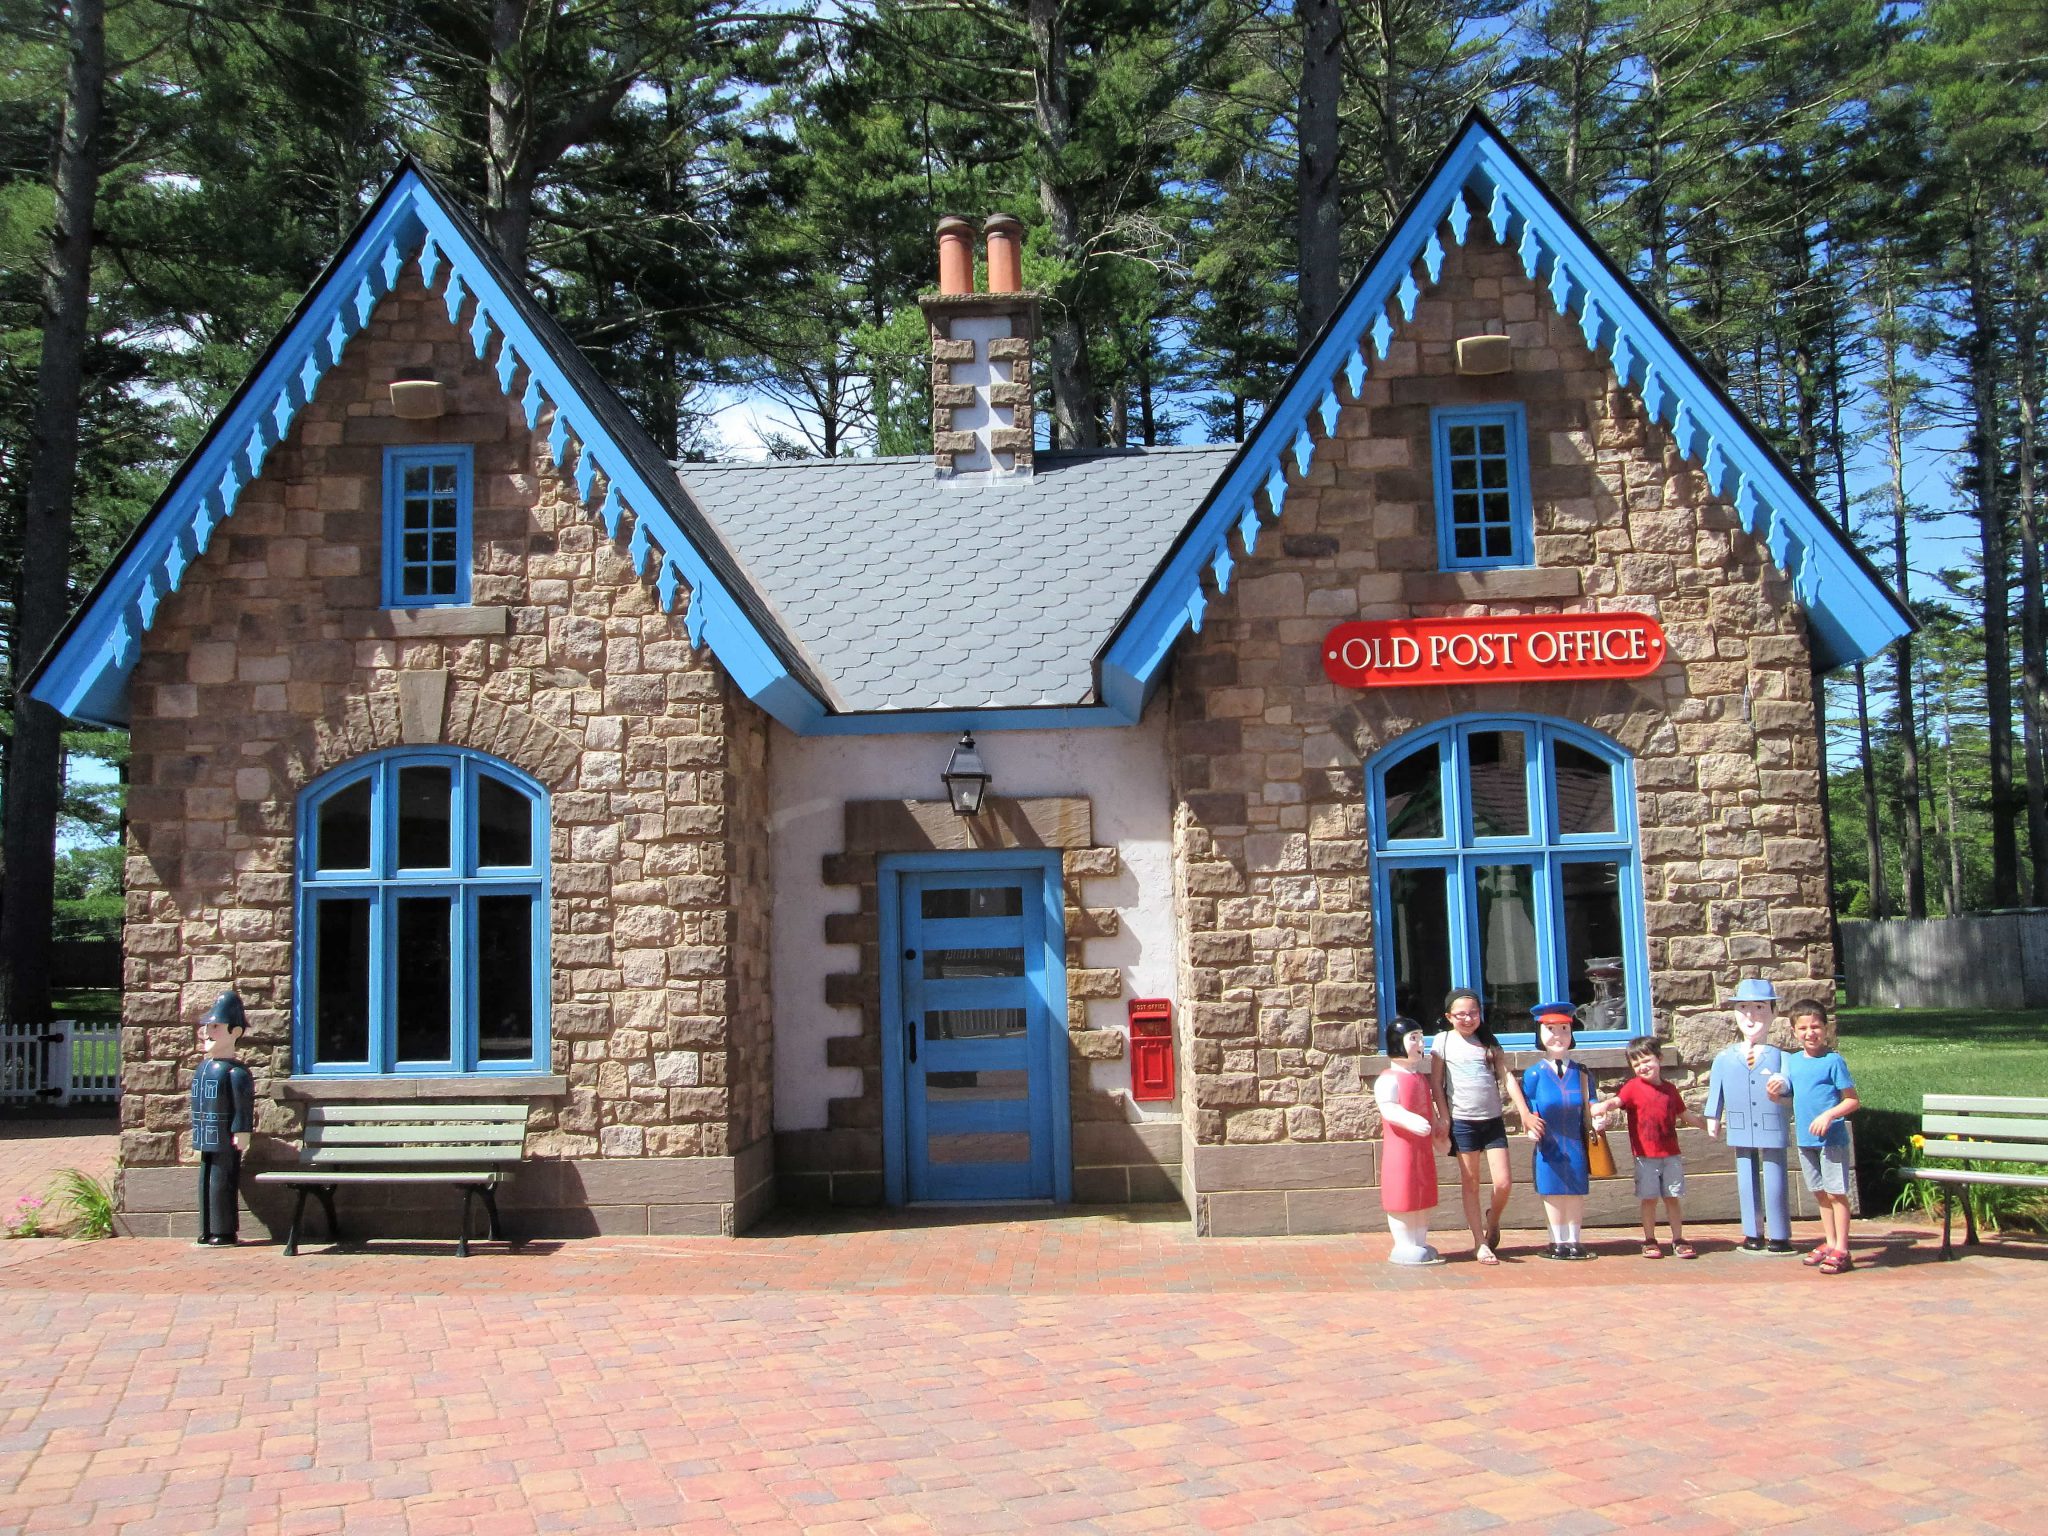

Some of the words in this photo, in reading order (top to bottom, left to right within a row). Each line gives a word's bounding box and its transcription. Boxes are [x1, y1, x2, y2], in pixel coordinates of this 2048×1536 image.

[1342, 637, 1420, 669] OLD
[1429, 633, 1518, 666] POST
[1527, 628, 1648, 663] OFFICE
